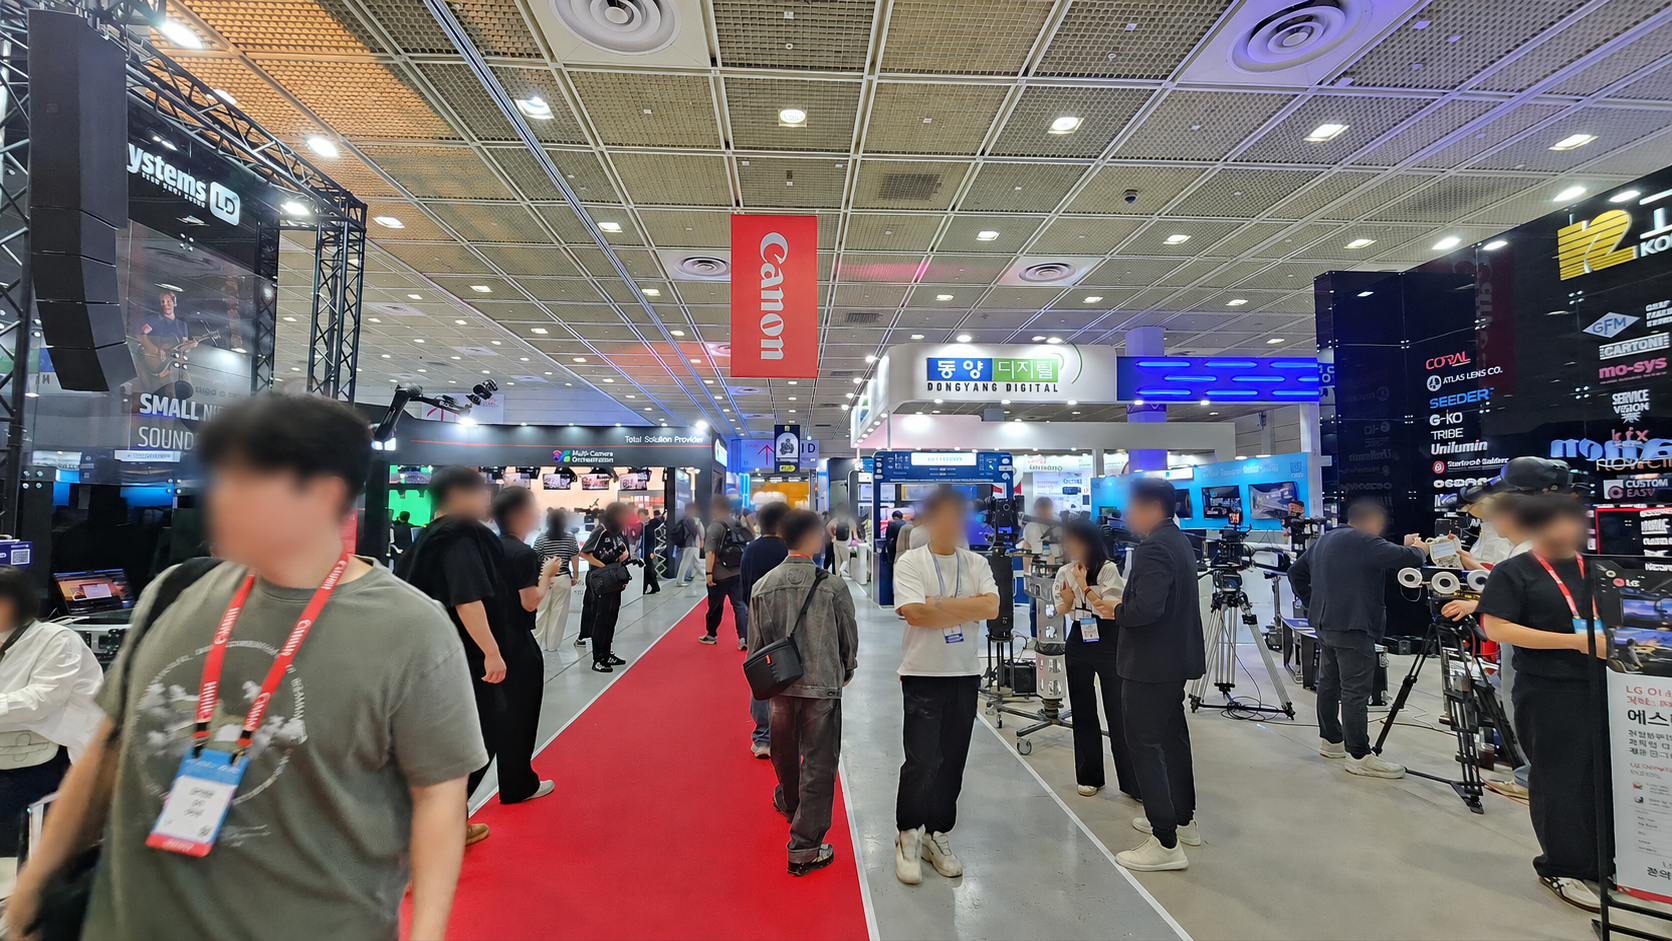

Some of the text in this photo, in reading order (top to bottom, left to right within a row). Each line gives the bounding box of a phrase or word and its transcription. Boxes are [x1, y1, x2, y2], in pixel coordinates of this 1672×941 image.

[127, 142, 207, 201] ystems
[1640, 234, 1672, 257] KO
[760, 232, 789, 360] Canon
[1592, 317, 1627, 335] GFM
[1603, 337, 1664, 357] CARTONI
[1425, 351, 1471, 370] CORAL
[1599, 357, 1668, 379] mo-sys
[1442, 366, 1504, 384] ATLAS LENS CO.
[927, 382, 1059, 393] DONGYANG DIGITAL
[1429, 388, 1490, 409] SEEDER
[1612, 389, 1650, 405] SERVICE
[139, 393, 200, 421] SMALL
[138, 426, 196, 450] SOUND
[625, 435, 642, 443] Total
[1430, 428, 1464, 440] TRIBE
[1430, 439, 1488, 455] Unilumin
[1625, 478, 1668, 488] CUSTOM
[1627, 709, 1672, 727] 에스
